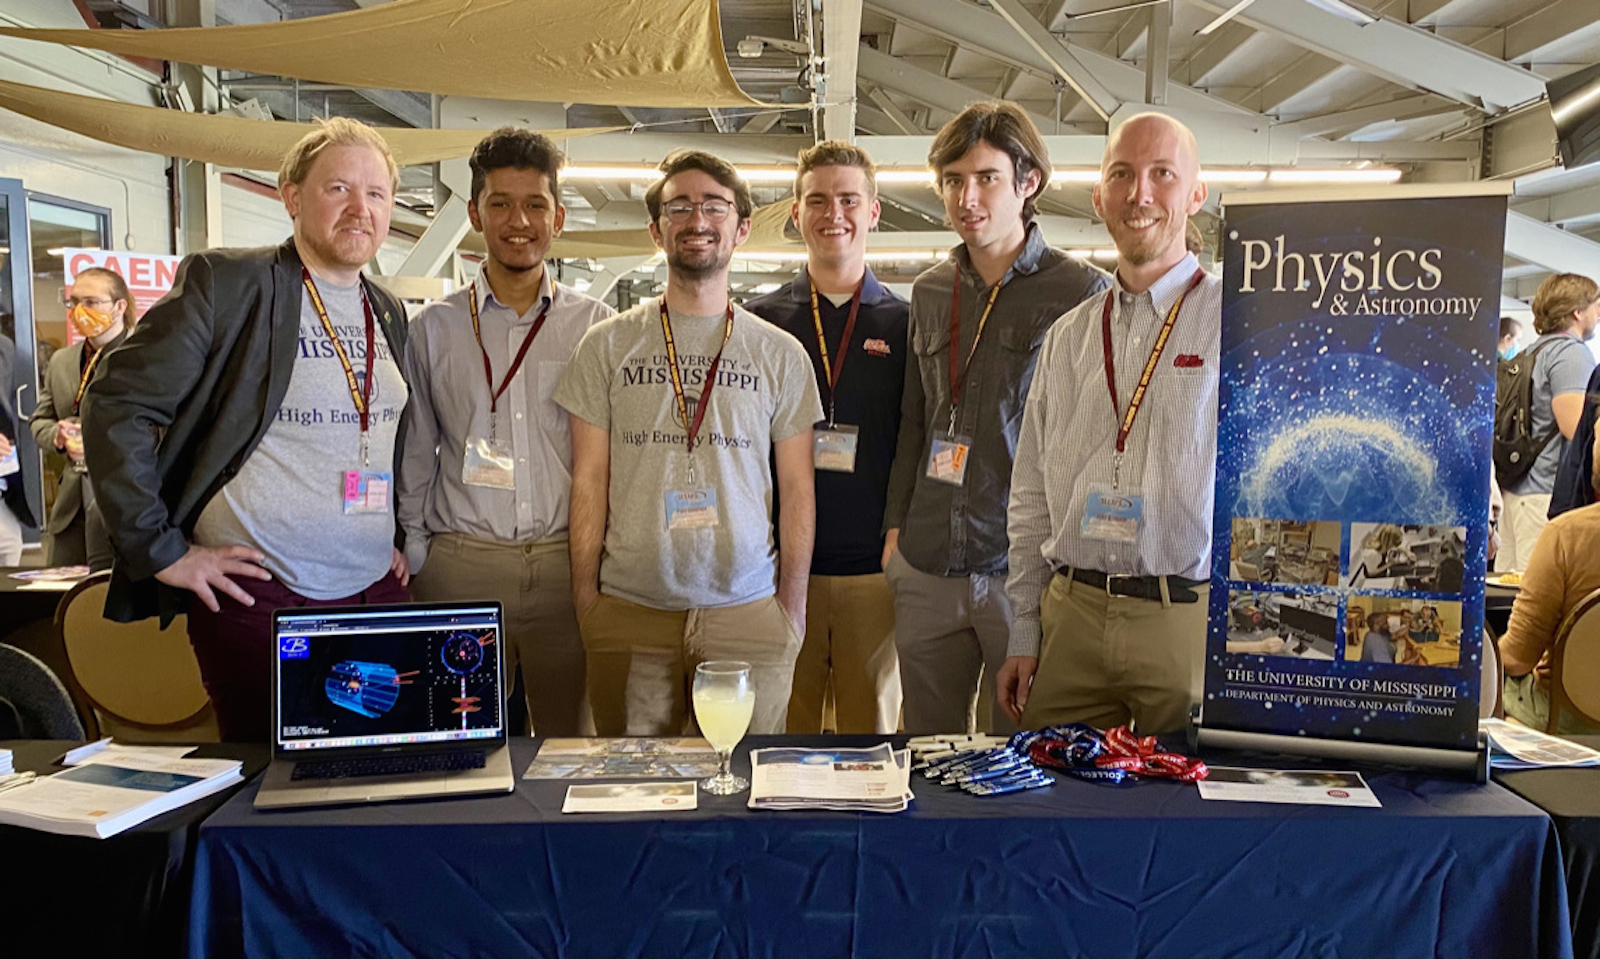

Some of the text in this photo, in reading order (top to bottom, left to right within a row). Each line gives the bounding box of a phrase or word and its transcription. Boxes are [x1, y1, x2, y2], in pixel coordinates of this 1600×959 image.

[1238, 234, 1443, 309] Physics
[1329, 293, 1483, 321] & Astronomy
[630, 357, 647, 366] THE
[653, 354, 737, 370] UNVERSTY
[622, 366, 759, 391] MISISIPPI
[279, 408, 323, 426] High
[330, 409, 379, 426] Enegy
[623, 430, 752, 449] High Enery Physics
[1225, 668, 1457, 699] THE UNIVERSITY OF MISSISSIPPI
[1225, 689, 1454, 717] DEPARTMENT OF PHYSICS AND ASTRONOMY
